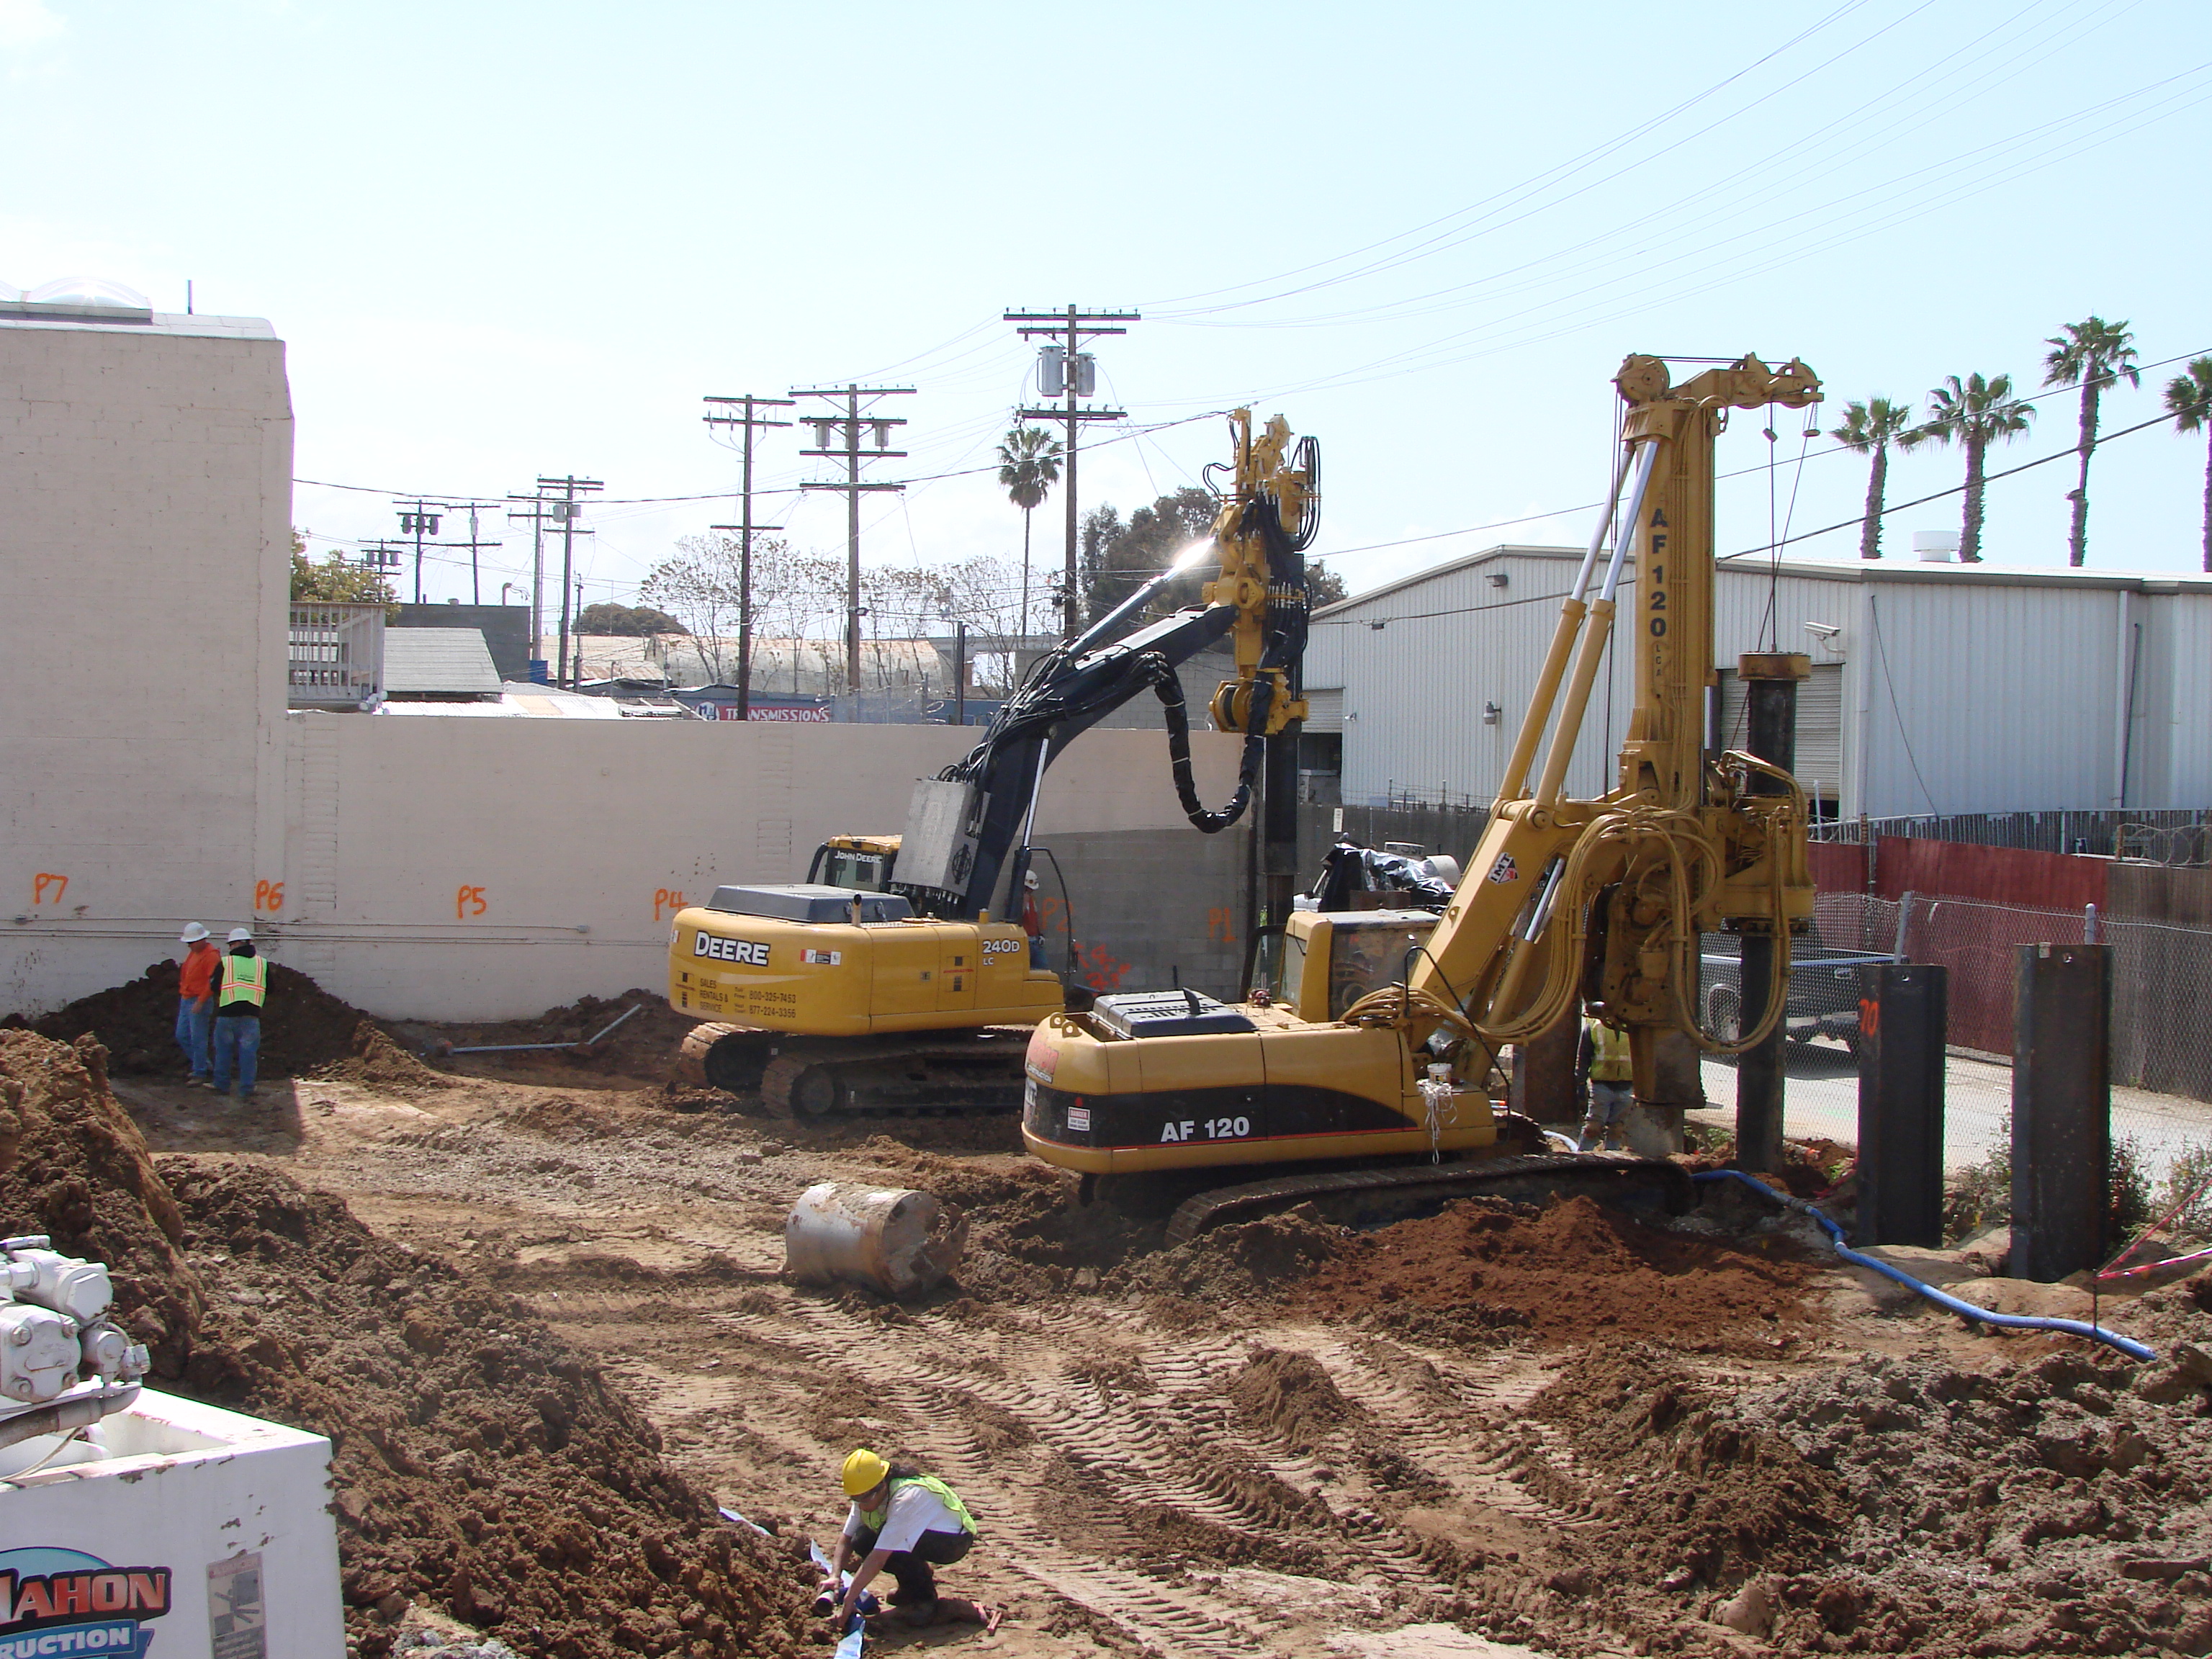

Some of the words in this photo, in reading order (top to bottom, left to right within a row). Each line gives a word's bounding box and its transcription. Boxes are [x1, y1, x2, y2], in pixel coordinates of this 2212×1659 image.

[835, 850, 855, 860] JOHN
[855, 853, 883, 863] DEERE
[1491, 853, 1510, 882] IMT
[33, 873, 68, 904] P7
[254, 879, 284, 912] P6
[456, 884, 487, 920] P5
[654, 888, 689, 921] P4
[1041, 897, 1076, 933] P2
[1208, 907, 1237, 943] P1
[695, 930, 770, 966] DEERE
[983, 939, 1020, 954] 240D
[983, 957, 994, 966] LC
[700, 978, 717, 989] SALES
[700, 989, 724, 1002] RENTALS
[700, 1001, 722, 1013] SERVICE
[1160, 1120, 1195, 1143] AF
[1204, 1116, 1250, 1138] 120
